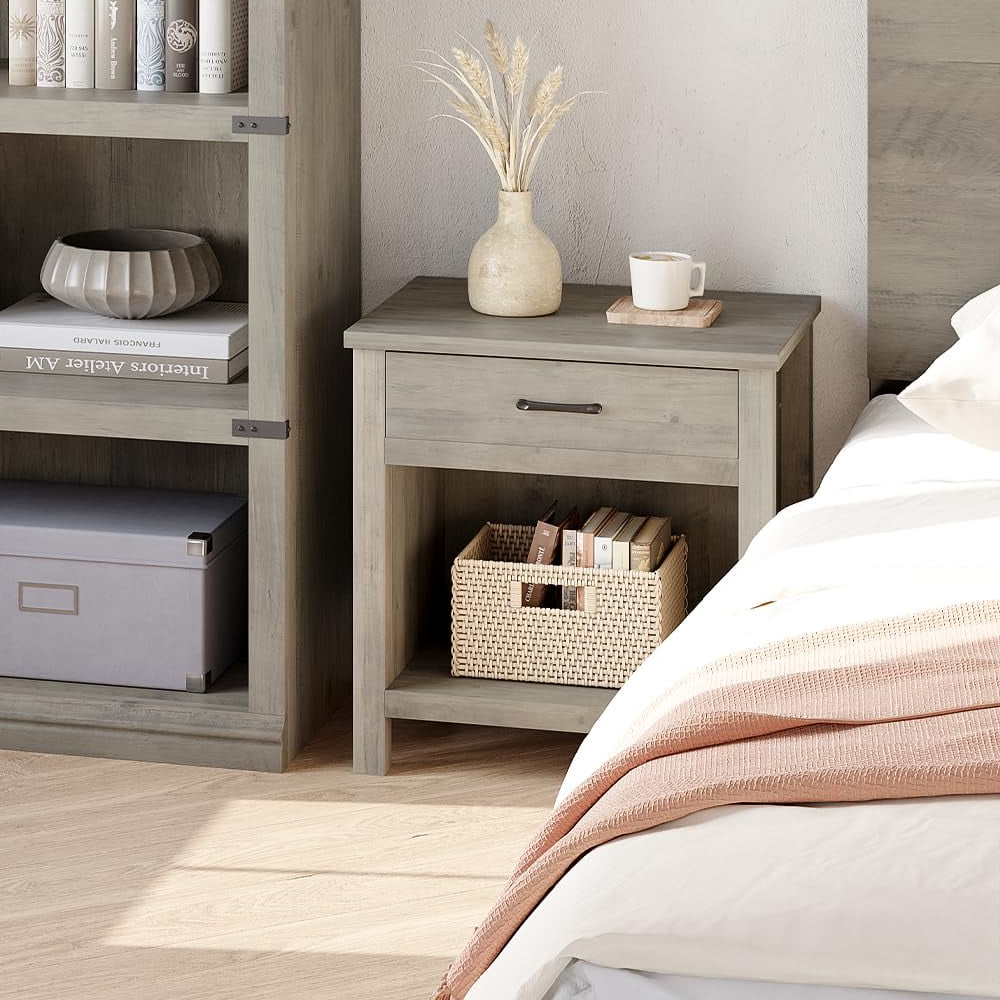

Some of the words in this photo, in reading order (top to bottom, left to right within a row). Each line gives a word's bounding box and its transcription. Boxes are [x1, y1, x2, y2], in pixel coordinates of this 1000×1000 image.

[73, 337, 112, 345] HALARD
[114, 337, 161, 348] FRANCOIS
[25, 356, 61, 370] AM
[65, 358, 125, 375] Atelier
[130, 360, 209, 379] Interiors
